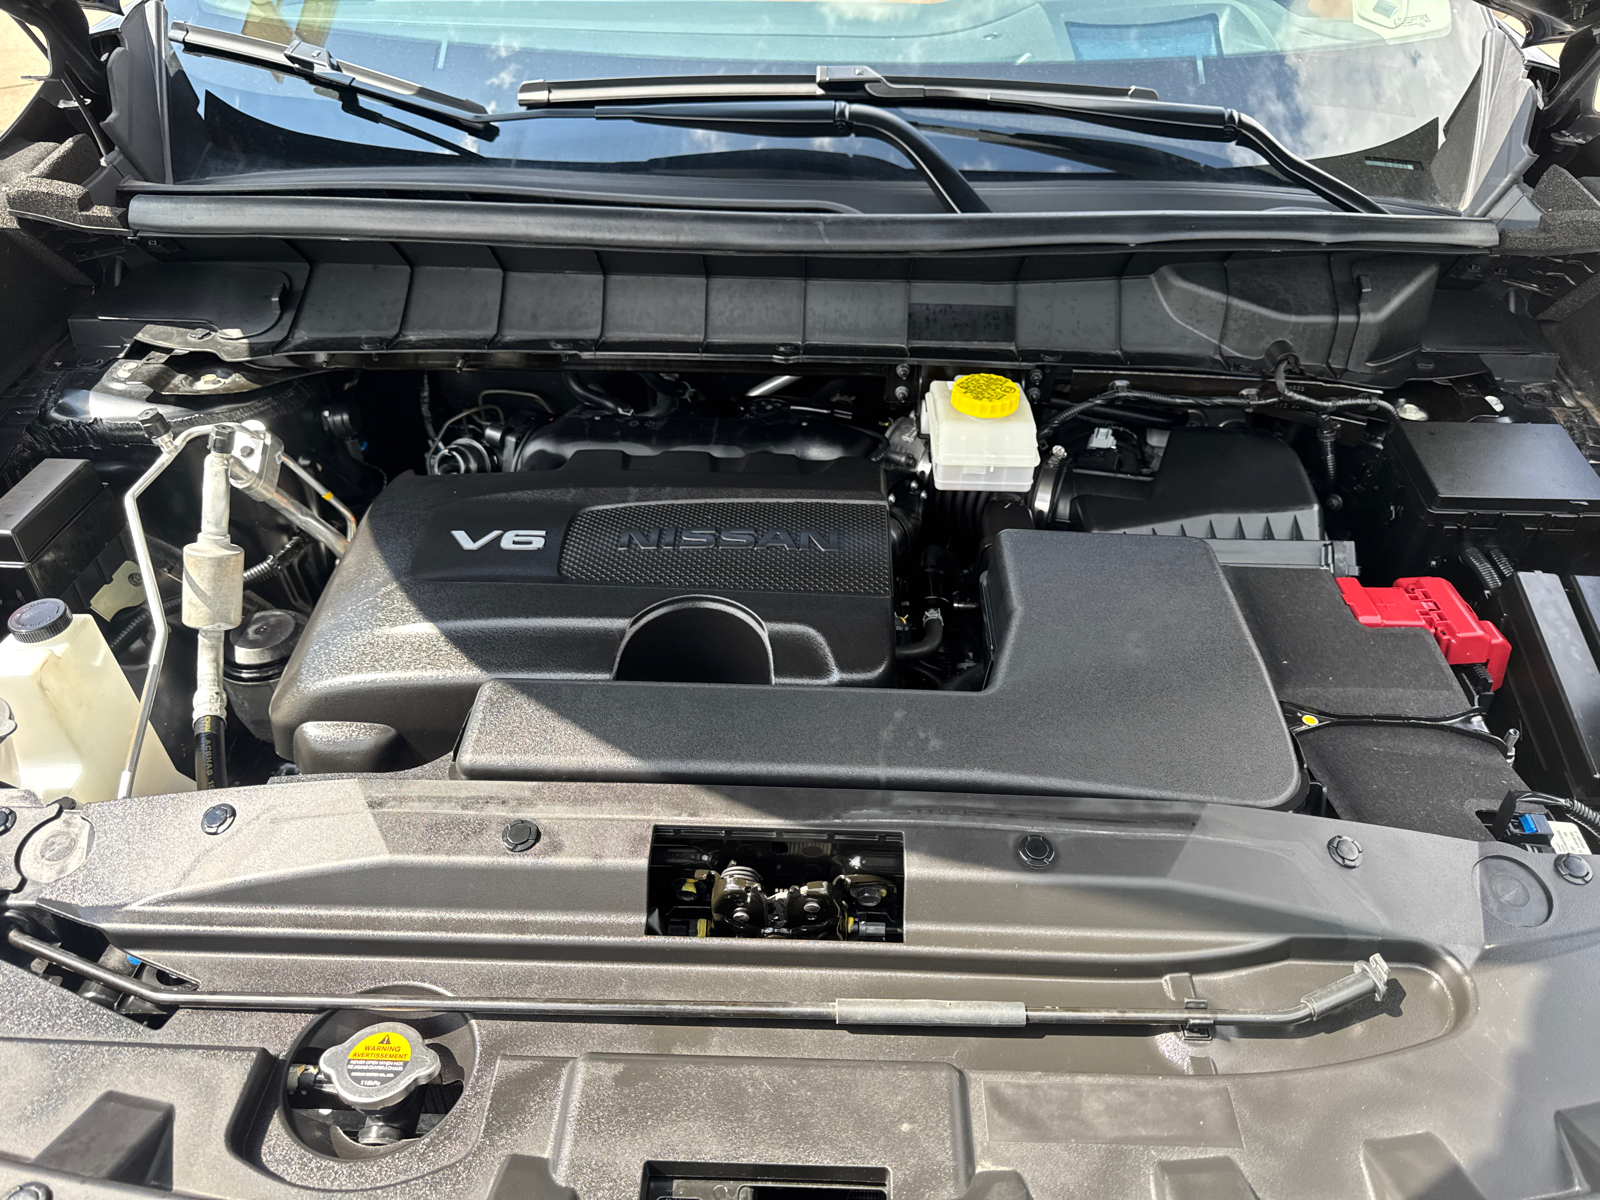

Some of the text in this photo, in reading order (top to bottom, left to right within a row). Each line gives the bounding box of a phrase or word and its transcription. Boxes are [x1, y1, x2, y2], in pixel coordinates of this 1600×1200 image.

[450, 530, 547, 551] V6
[618, 526, 839, 551] NISSAN
[364, 1045, 401, 1053] WARNING
